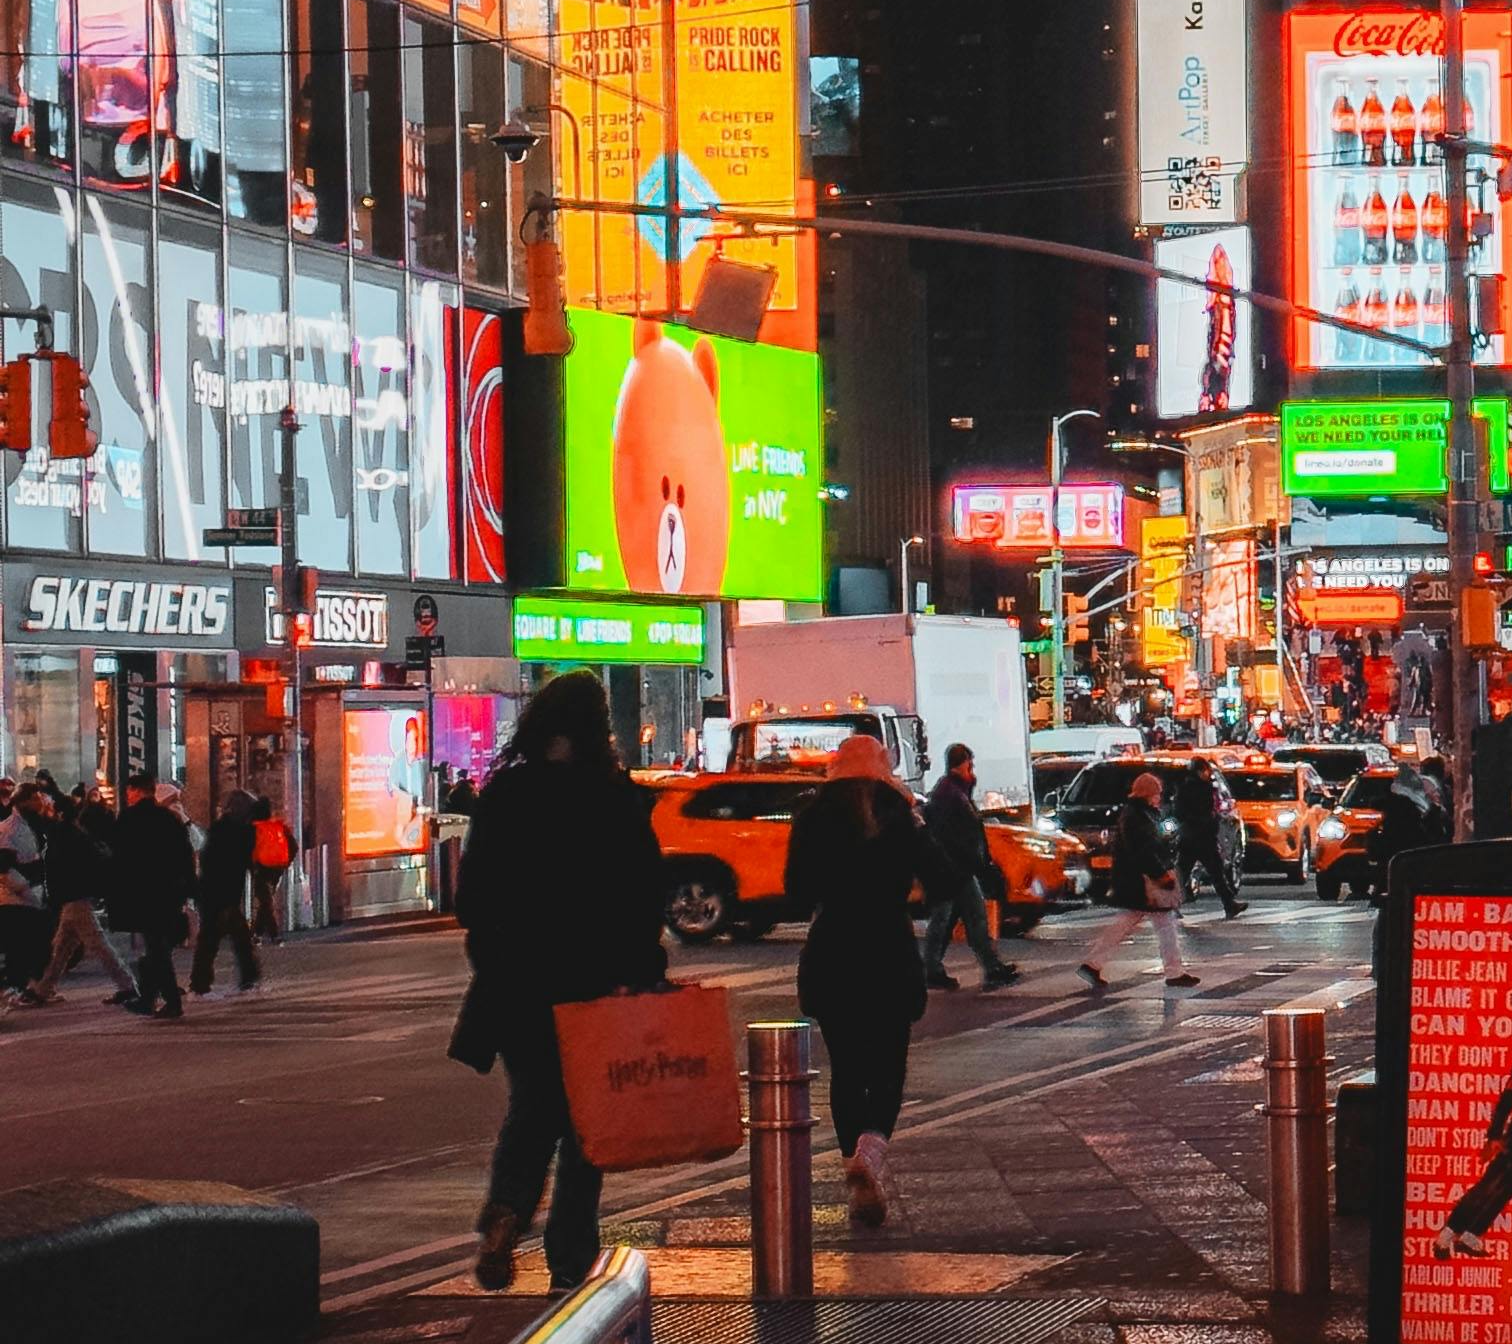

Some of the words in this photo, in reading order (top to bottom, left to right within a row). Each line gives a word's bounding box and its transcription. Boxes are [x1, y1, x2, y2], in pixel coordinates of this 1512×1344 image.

[689, 27, 735, 46] PRIDE
[738, 28, 780, 47] ROCK
[704, 49, 782, 72] CALLING
[700, 111, 775, 124] ACHETER
[721, 129, 752, 141] DES
[704, 146, 770, 159] BILLETS
[727, 164, 748, 176] ICI
[1296, 414, 1324, 428] LOS
[1327, 413, 1399, 427] ANGELES
[1403, 413, 1419, 426] IS
[1296, 431, 1319, 444] WE
[1324, 431, 1366, 444] NEED
[1369, 430, 1412, 443] YOUR
[1296, 559, 1328, 574] LS
[1328, 558, 1403, 573] ANGELES
[1405, 558, 1423, 572] IS
[1423, 557, 1451, 572] ON
[1324, 575, 1368, 588] NEED
[27, 575, 230, 635] SKECHERS
[314, 597, 385, 642] TISSOT
[1414, 901, 1465, 923] JAM
[1412, 959, 1461, 981] BILLIE
[1466, 961, 1508, 983] JEAN
[1411, 987, 1472, 1009] BLAME
[1480, 989, 1498, 1010] IT
[1411, 1015, 1466, 1037] CAN
[1410, 1043, 1452, 1066] THEY
[1458, 1046, 1508, 1068] DON'T
[1407, 1099, 1460, 1122] MAN
[1469, 1101, 1493, 1123] IN
[1407, 1126, 1449, 1149] DON'T
[1452, 1127, 1488, 1150] STOP
[1406, 1154, 1442, 1177] KEEP
[1445, 1155, 1472, 1177] THE
[1405, 1182, 1475, 1205] BEA
[1403, 1264, 1454, 1287] TABLOID
[1457, 1267, 1503, 1289] JUNKIE
[1402, 1291, 1495, 1316] THRILLER
[1401, 1319, 1455, 1342] WANNA
[1460, 1322, 1480, 1344] BE
